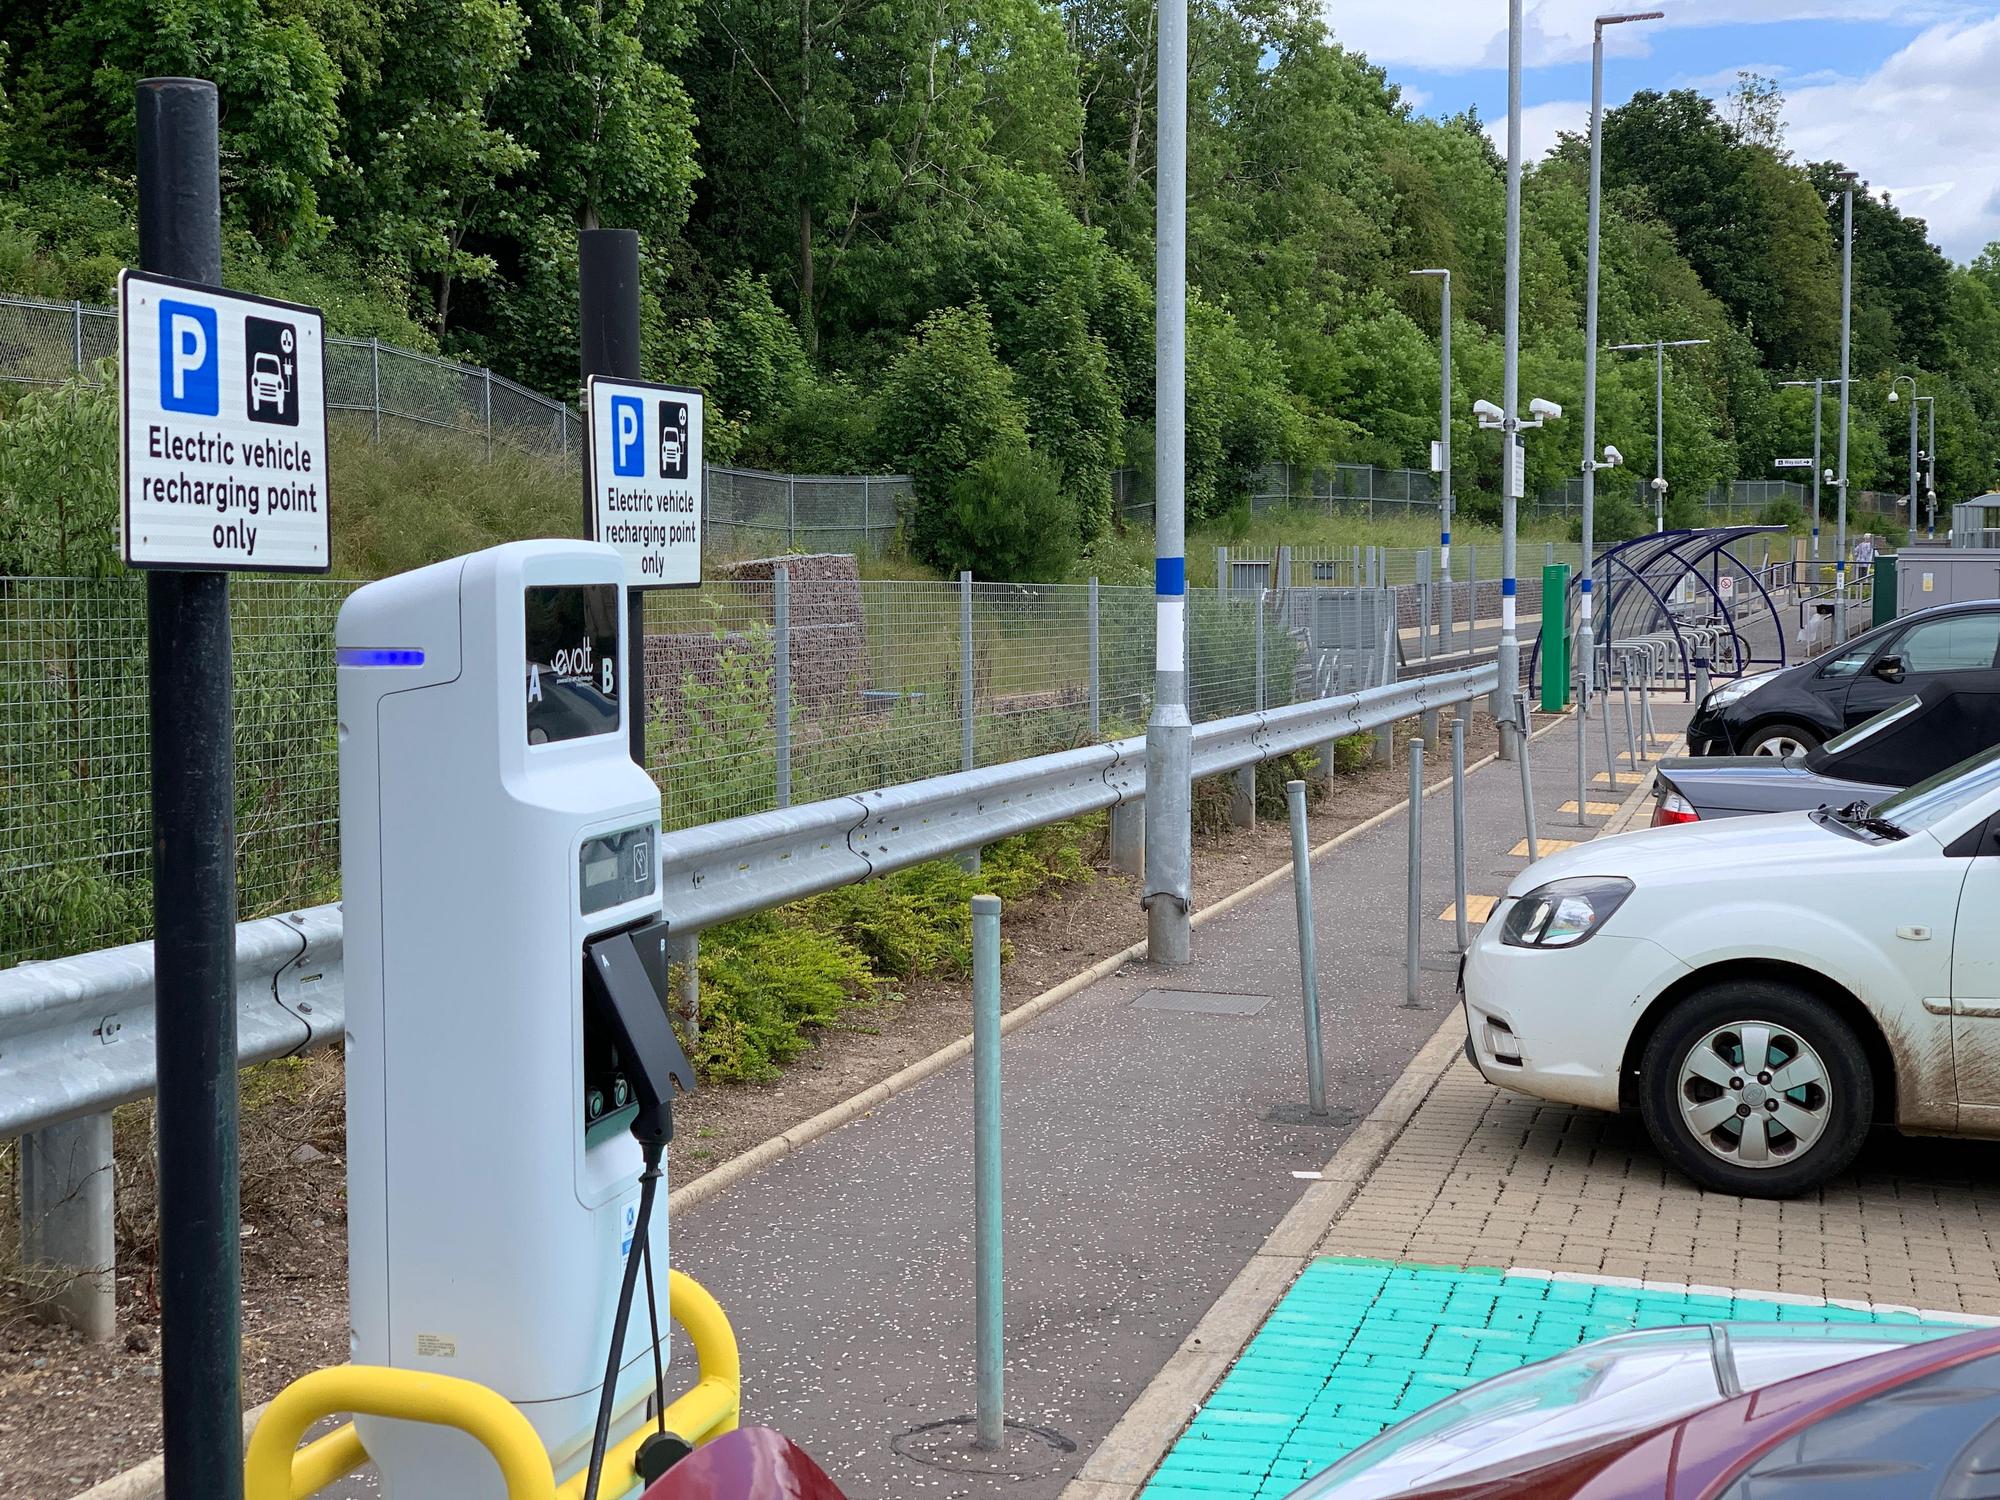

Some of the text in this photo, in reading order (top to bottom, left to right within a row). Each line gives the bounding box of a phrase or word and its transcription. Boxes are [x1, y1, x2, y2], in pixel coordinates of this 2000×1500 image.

[172, 313, 207, 399] P
[149, 425, 311, 472] Electric vehicle
[618, 404, 638, 467] P
[143, 472, 317, 515] recharging point
[608, 487, 694, 513] Electric vehicle
[213, 518, 257, 556] only
[606, 520, 696, 548] recharging point
[641, 550, 665, 578] only
[551, 636, 593, 675] evolt
[528, 664, 543, 703] A
[602, 657, 614, 694] B
[601, 954, 609, 967] A
[660, 938, 666, 951] B
